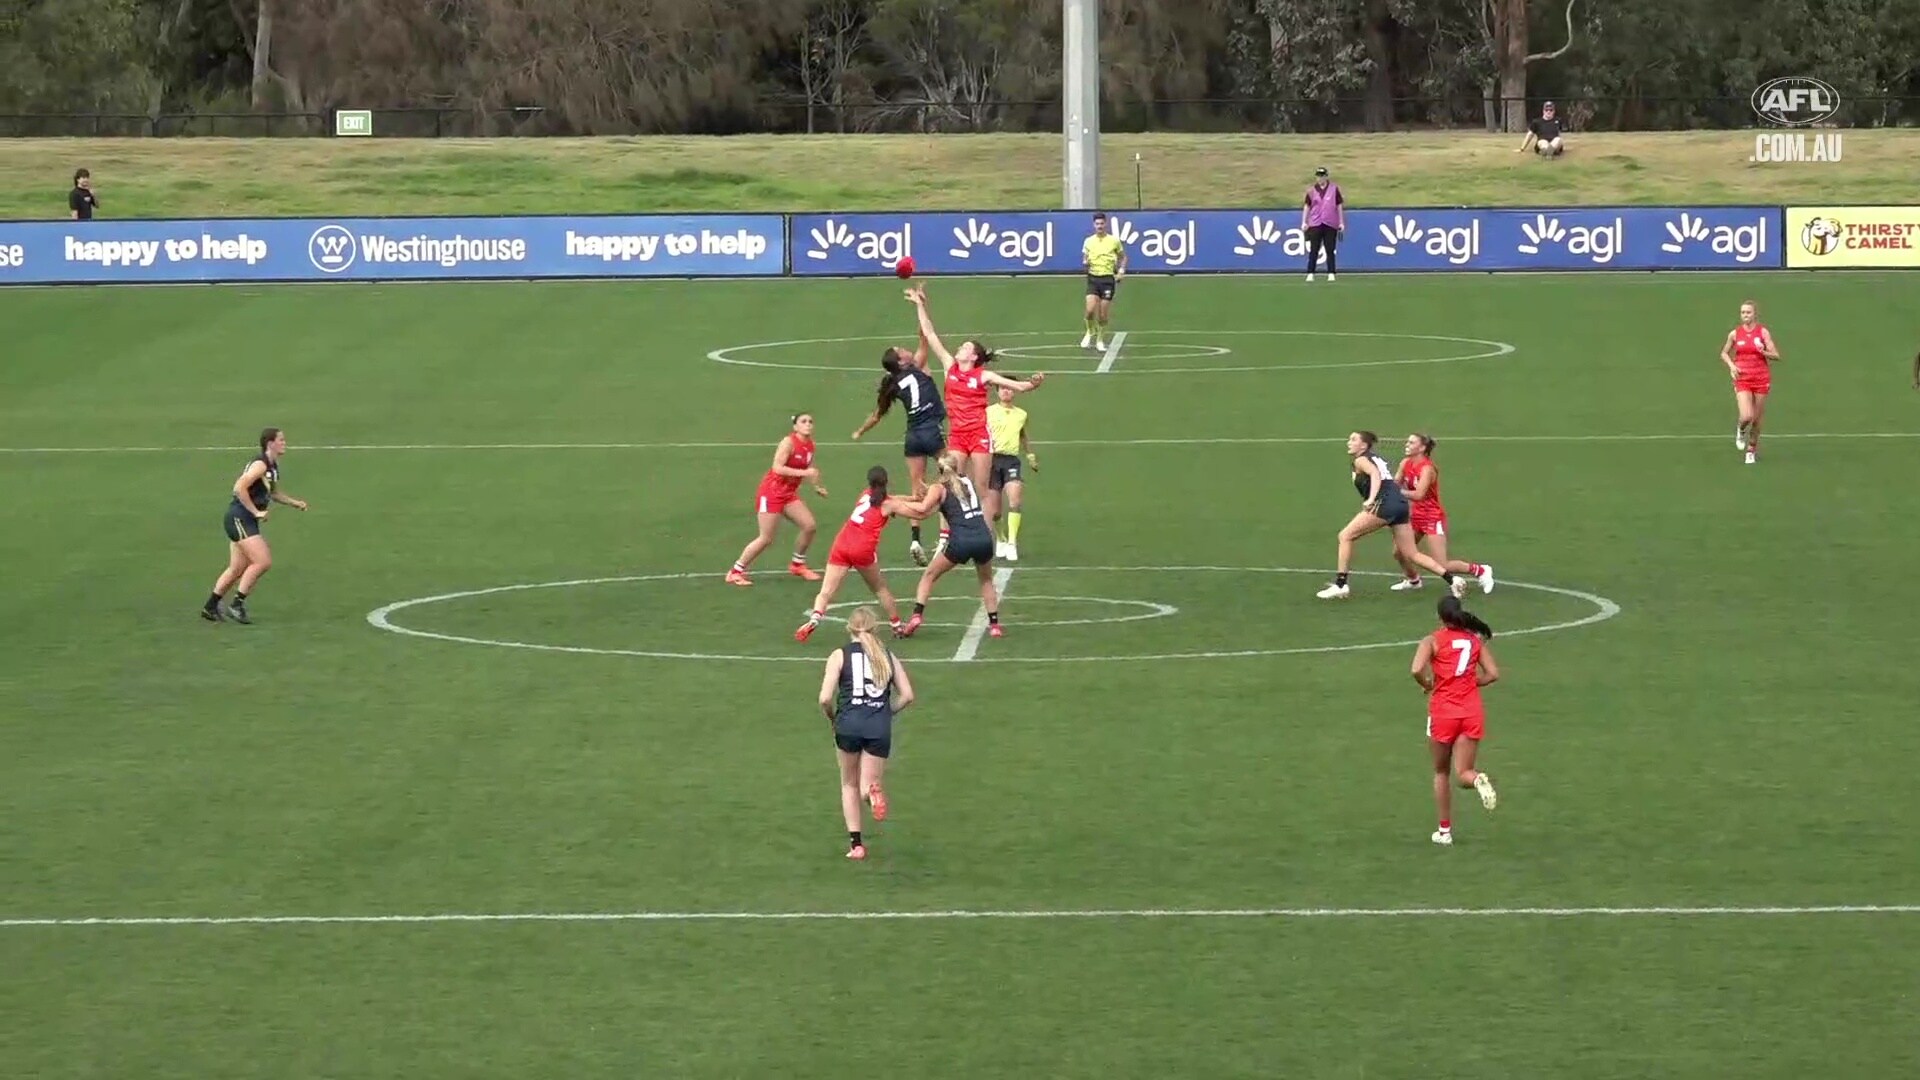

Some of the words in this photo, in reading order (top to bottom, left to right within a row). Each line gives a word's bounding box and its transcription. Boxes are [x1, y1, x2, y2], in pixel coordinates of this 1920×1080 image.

[343, 116, 365, 130] EXIT
[65, 235, 159, 267] happy
[164, 238, 198, 262] to
[202, 234, 267, 265] help
[361, 234, 526, 267] Westinghouse
[566, 230, 660, 262] happy
[664, 232, 698, 257] to
[701, 229, 767, 261] help
[857, 223, 911, 269] agl
[999, 222, 1053, 267] agl
[1141, 221, 1195, 266] agl
[1426, 219, 1479, 265] agl
[1568, 218, 1622, 263] agl
[1711, 217, 1766, 263] agl
[1845, 237, 1913, 249] CAMEL
[897, 374, 920, 409] 7
[850, 494, 871, 524] 2
[1452, 638, 1473, 678] 7
